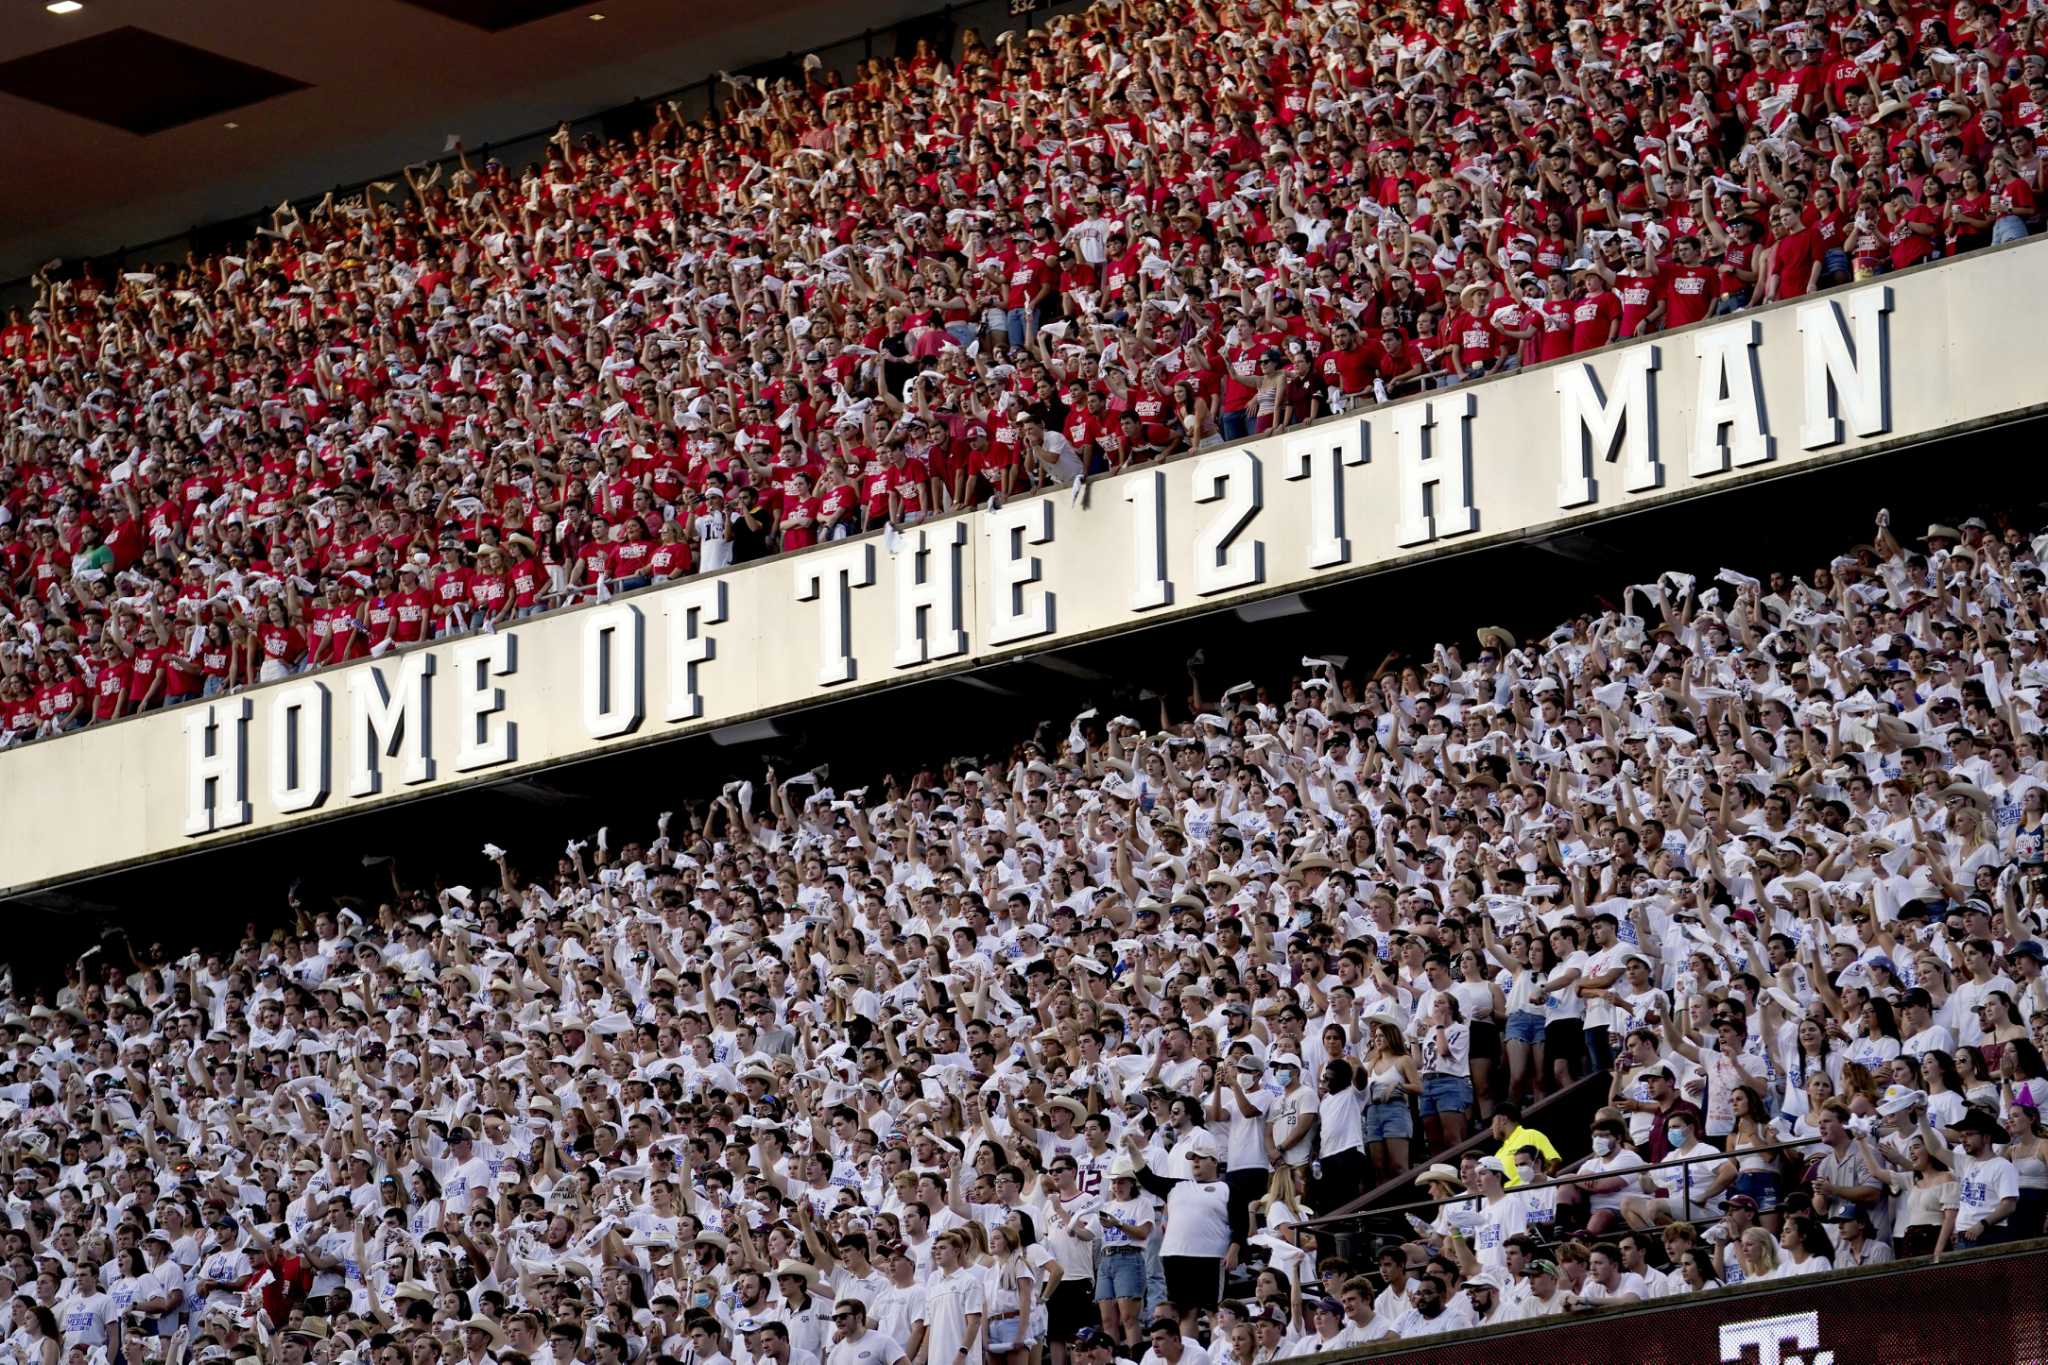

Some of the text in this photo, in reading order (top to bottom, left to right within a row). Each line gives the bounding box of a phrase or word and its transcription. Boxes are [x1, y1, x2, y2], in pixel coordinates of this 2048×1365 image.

[184, 284, 1895, 837] HOME OF THE 12TH MAN
[1078, 1169, 1102, 1197] 12
